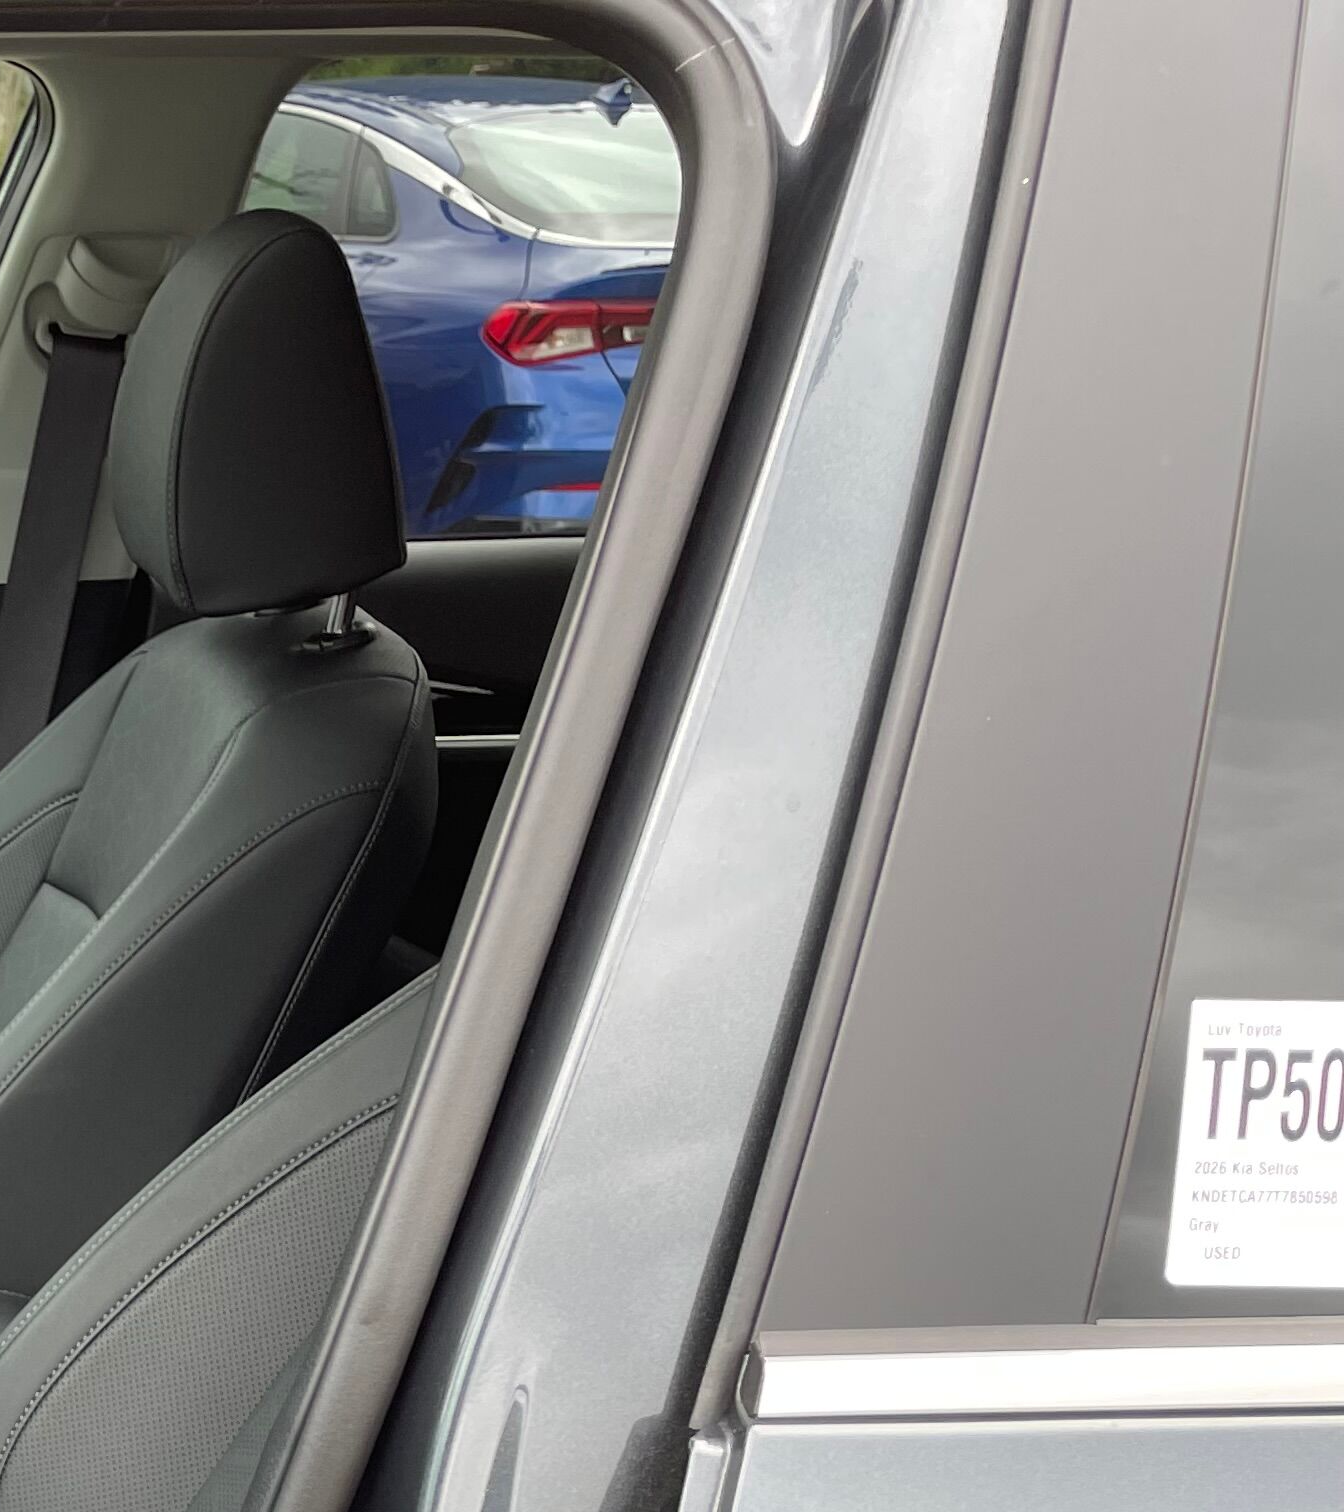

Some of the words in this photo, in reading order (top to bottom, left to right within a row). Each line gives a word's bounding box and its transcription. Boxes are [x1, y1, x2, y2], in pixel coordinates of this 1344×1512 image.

[1208, 1024, 1231, 1036] Luv
[1239, 1023, 1282, 1037] Toyota
[1194, 1161, 1227, 1175] 2026
[1232, 1162, 1253, 1175] Kia
[1258, 1161, 1299, 1175] Seltos
[1189, 1217, 1218, 1233] Gray
[1204, 1246, 1241, 1260] USED
